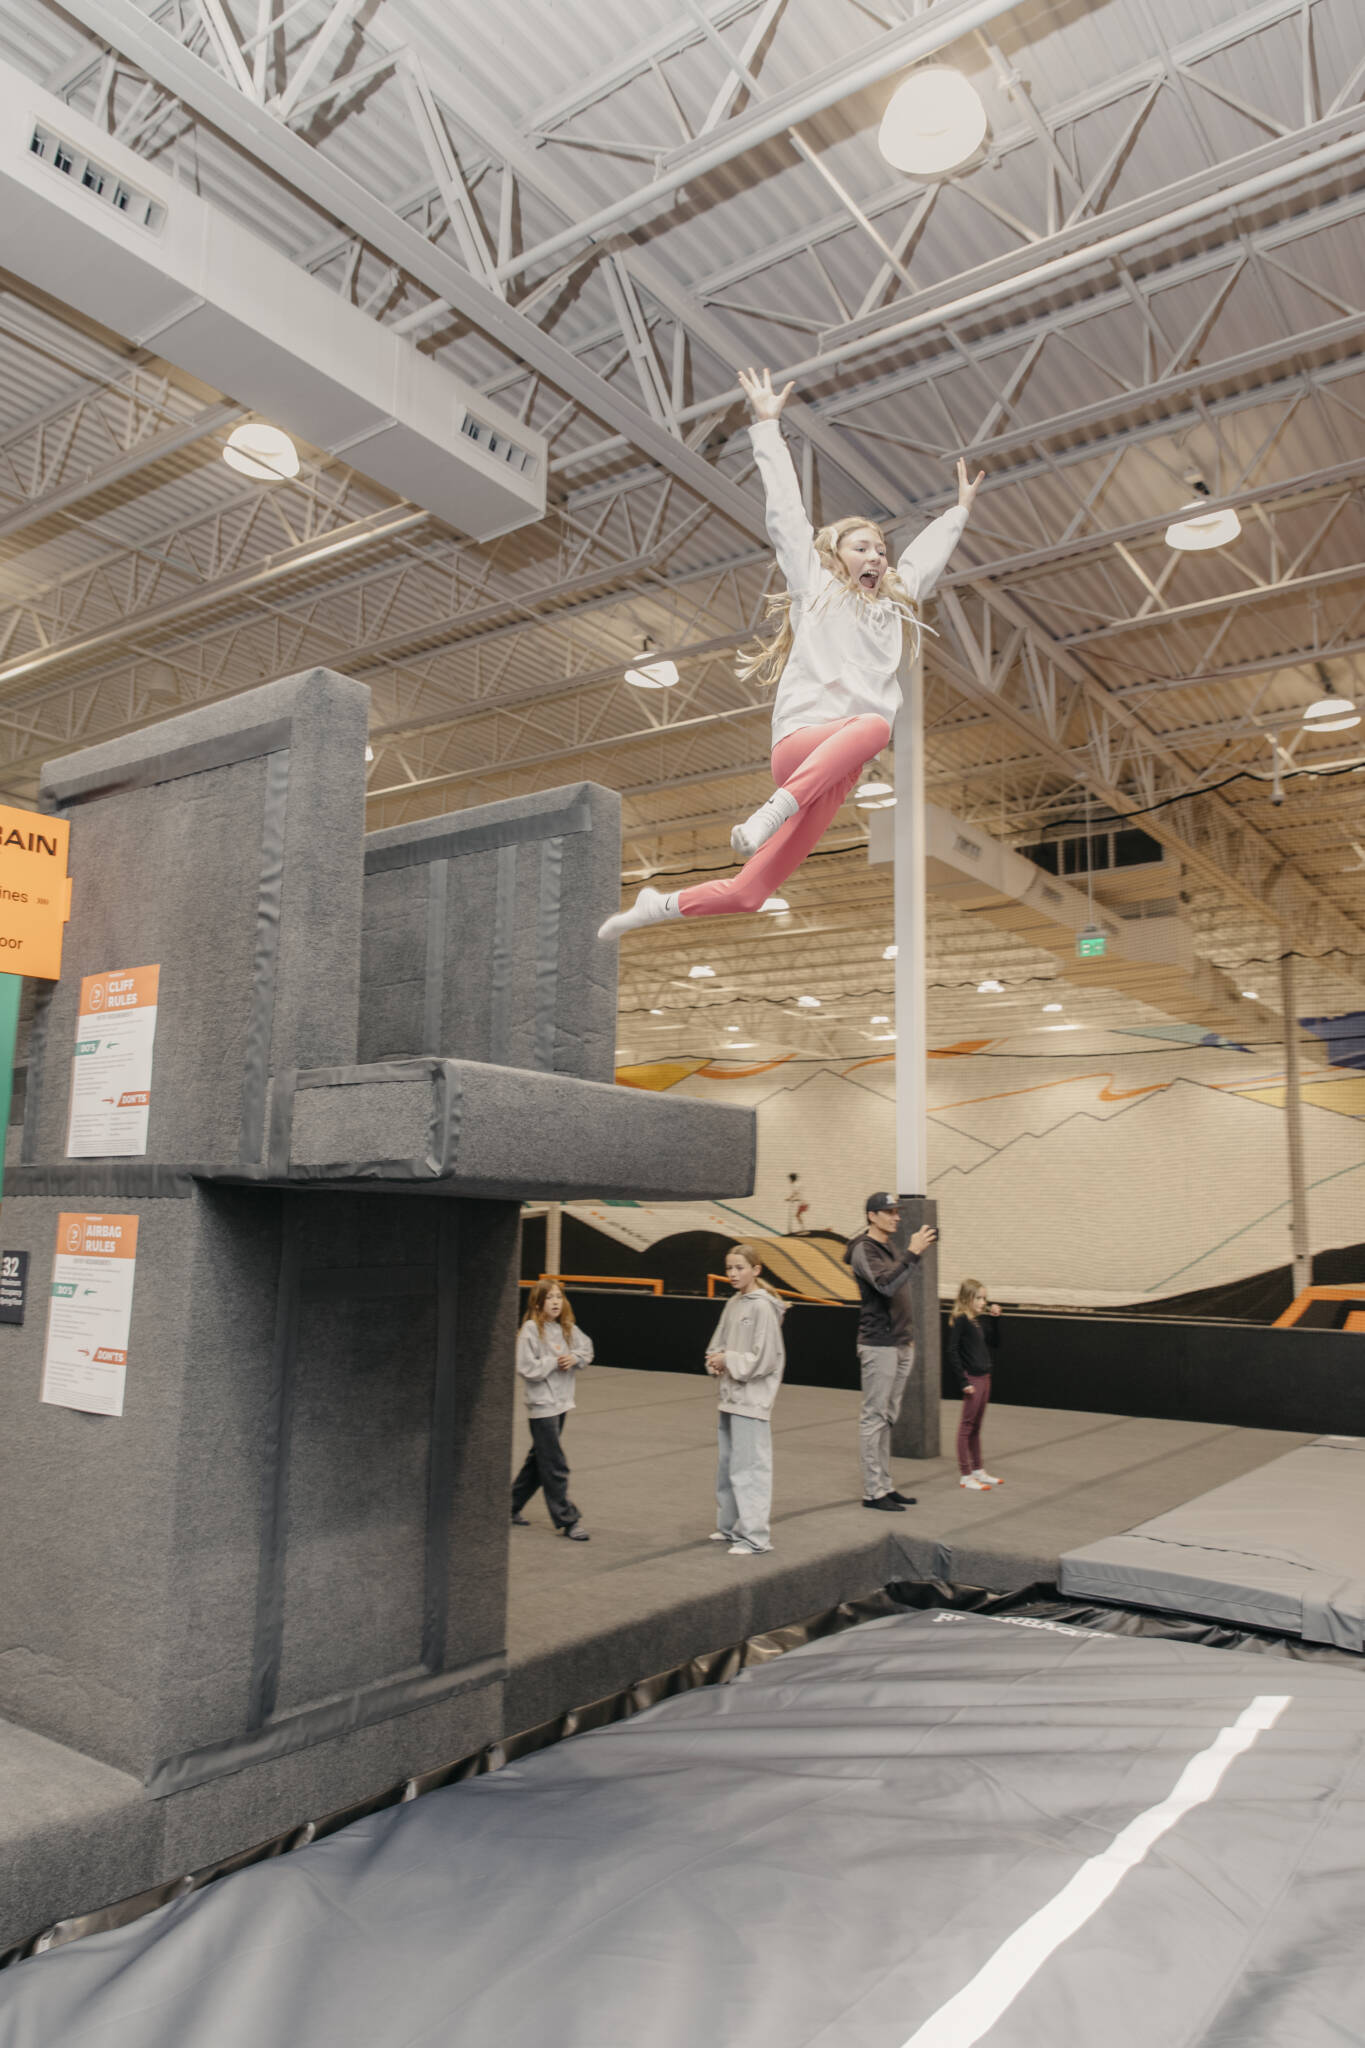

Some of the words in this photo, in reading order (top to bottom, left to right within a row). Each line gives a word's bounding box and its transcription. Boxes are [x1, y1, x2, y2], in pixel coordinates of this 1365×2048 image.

[0, 826, 57, 856] AIN
[108, 978, 135, 993] CLIFF
[107, 993, 137, 1008] RULES
[86, 1224, 123, 1238] AIRBAG
[85, 1239, 116, 1253] RULES
[2, 1256, 19, 1277] 32
